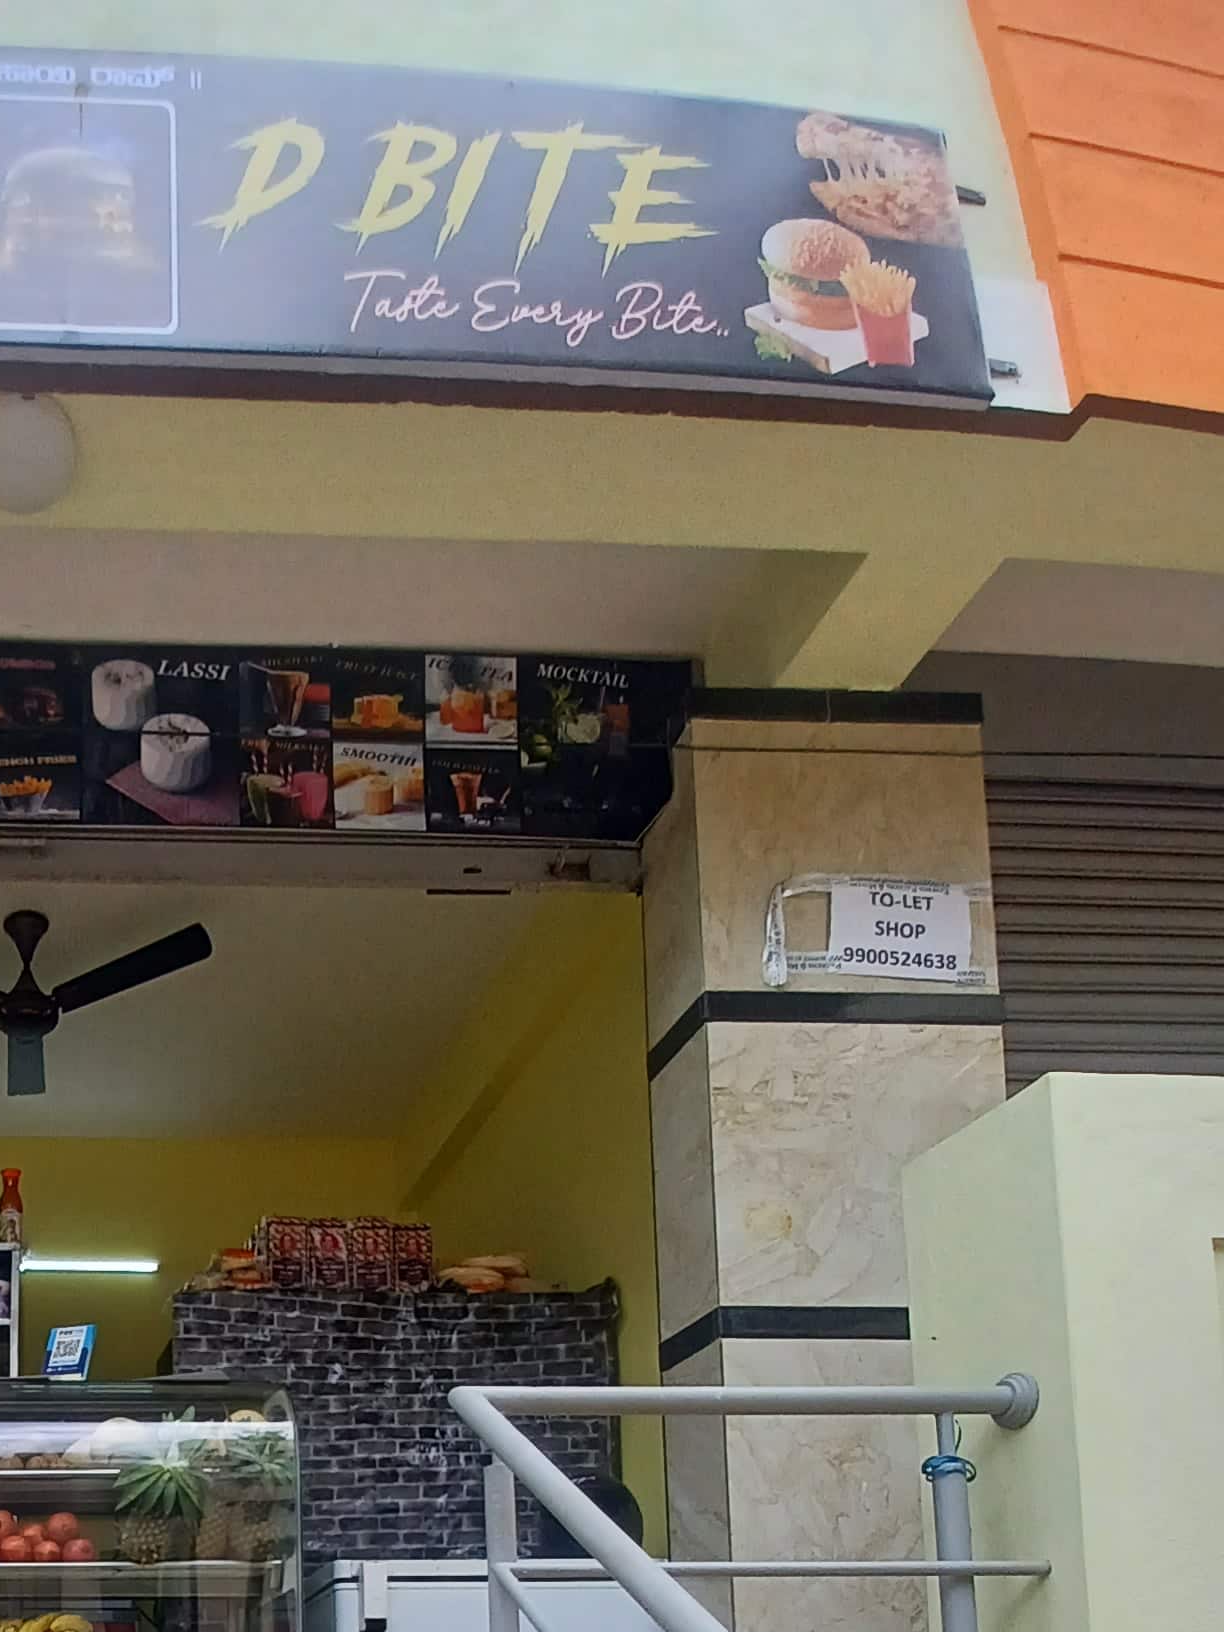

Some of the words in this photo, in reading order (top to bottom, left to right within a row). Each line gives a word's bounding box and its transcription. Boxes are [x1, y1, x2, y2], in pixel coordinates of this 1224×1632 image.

[194, 117, 325, 252] D
[335, 118, 721, 279] BITE
[343, 270, 459, 334] Taste
[471, 279, 604, 348] Every
[156, 659, 230, 682] LASSI
[537, 663, 630, 689] MOCKTAIL
[870, 891, 934, 911] TO-LET
[875, 920, 926, 939] SHOP
[843, 946, 957, 970] 9900524638
